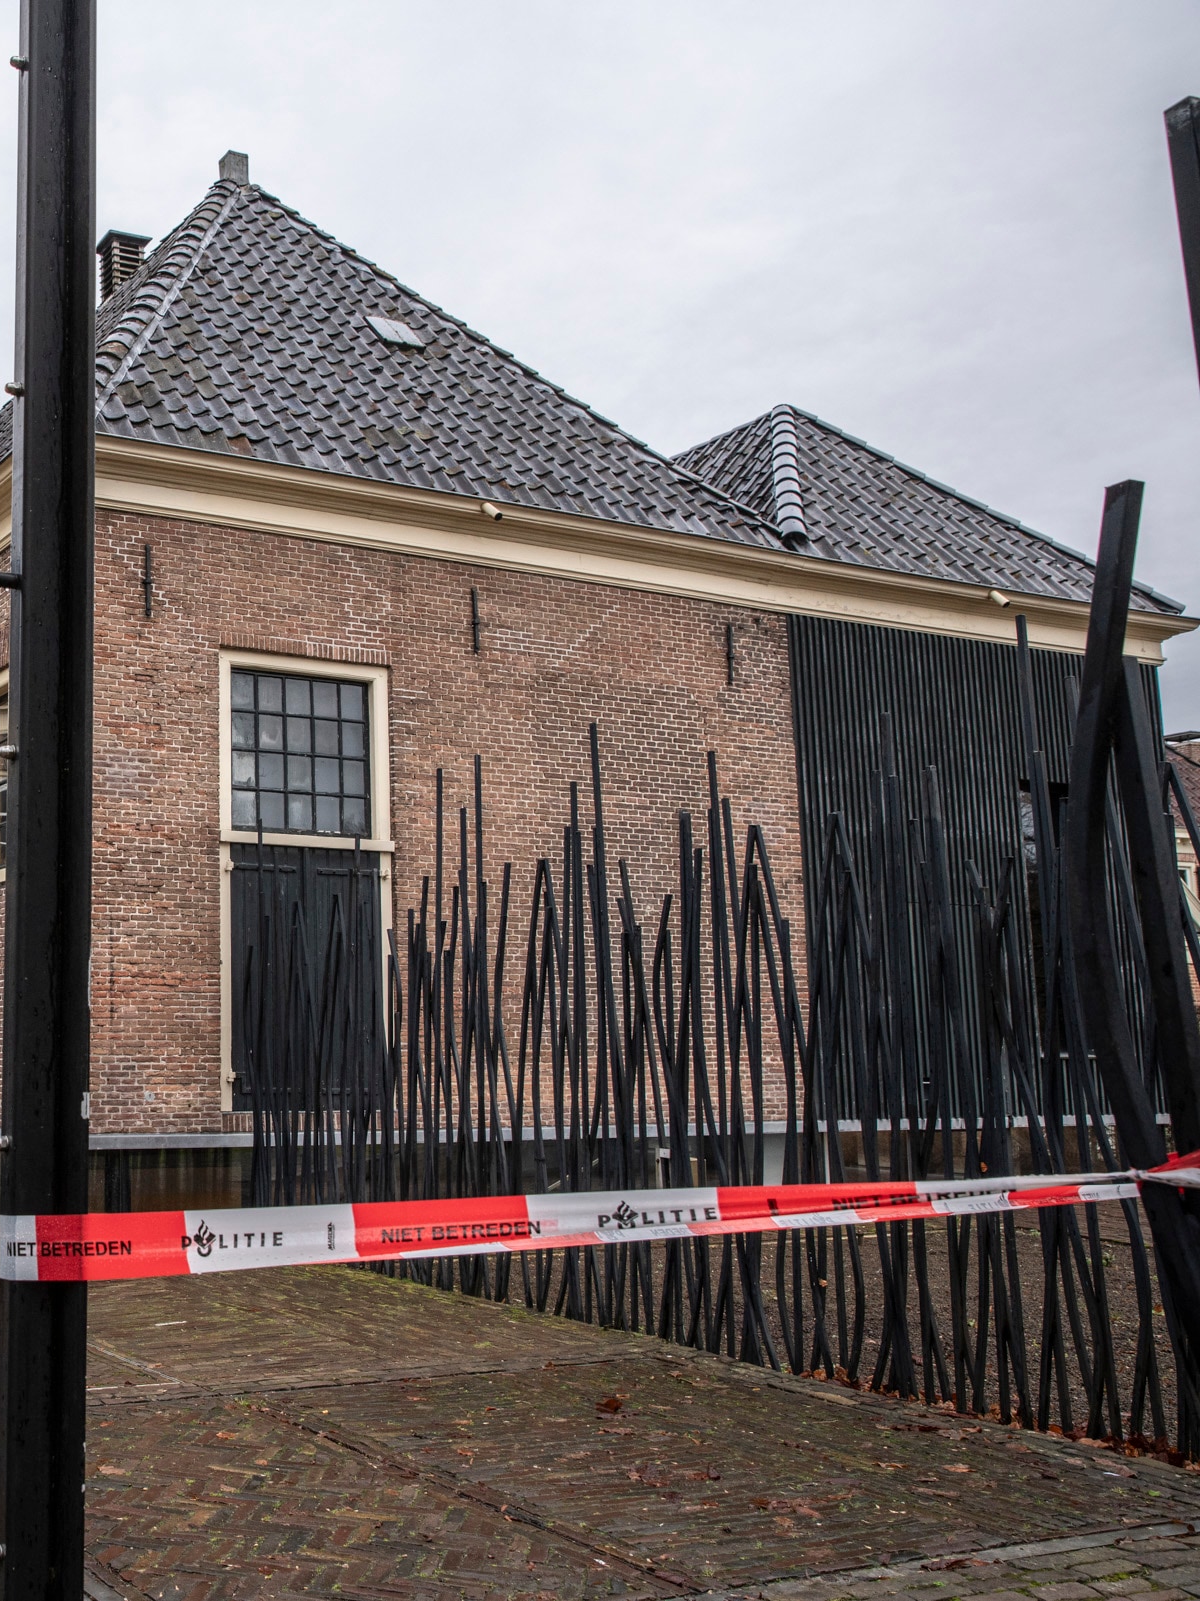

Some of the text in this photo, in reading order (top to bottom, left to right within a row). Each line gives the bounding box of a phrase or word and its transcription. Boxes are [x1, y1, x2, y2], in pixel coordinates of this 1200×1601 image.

[181, 1225, 283, 1257] POLITIE
[381, 1220, 542, 1244] NIET BETREDEN
[6, 1240, 132, 1257] NIET BETREDEN
